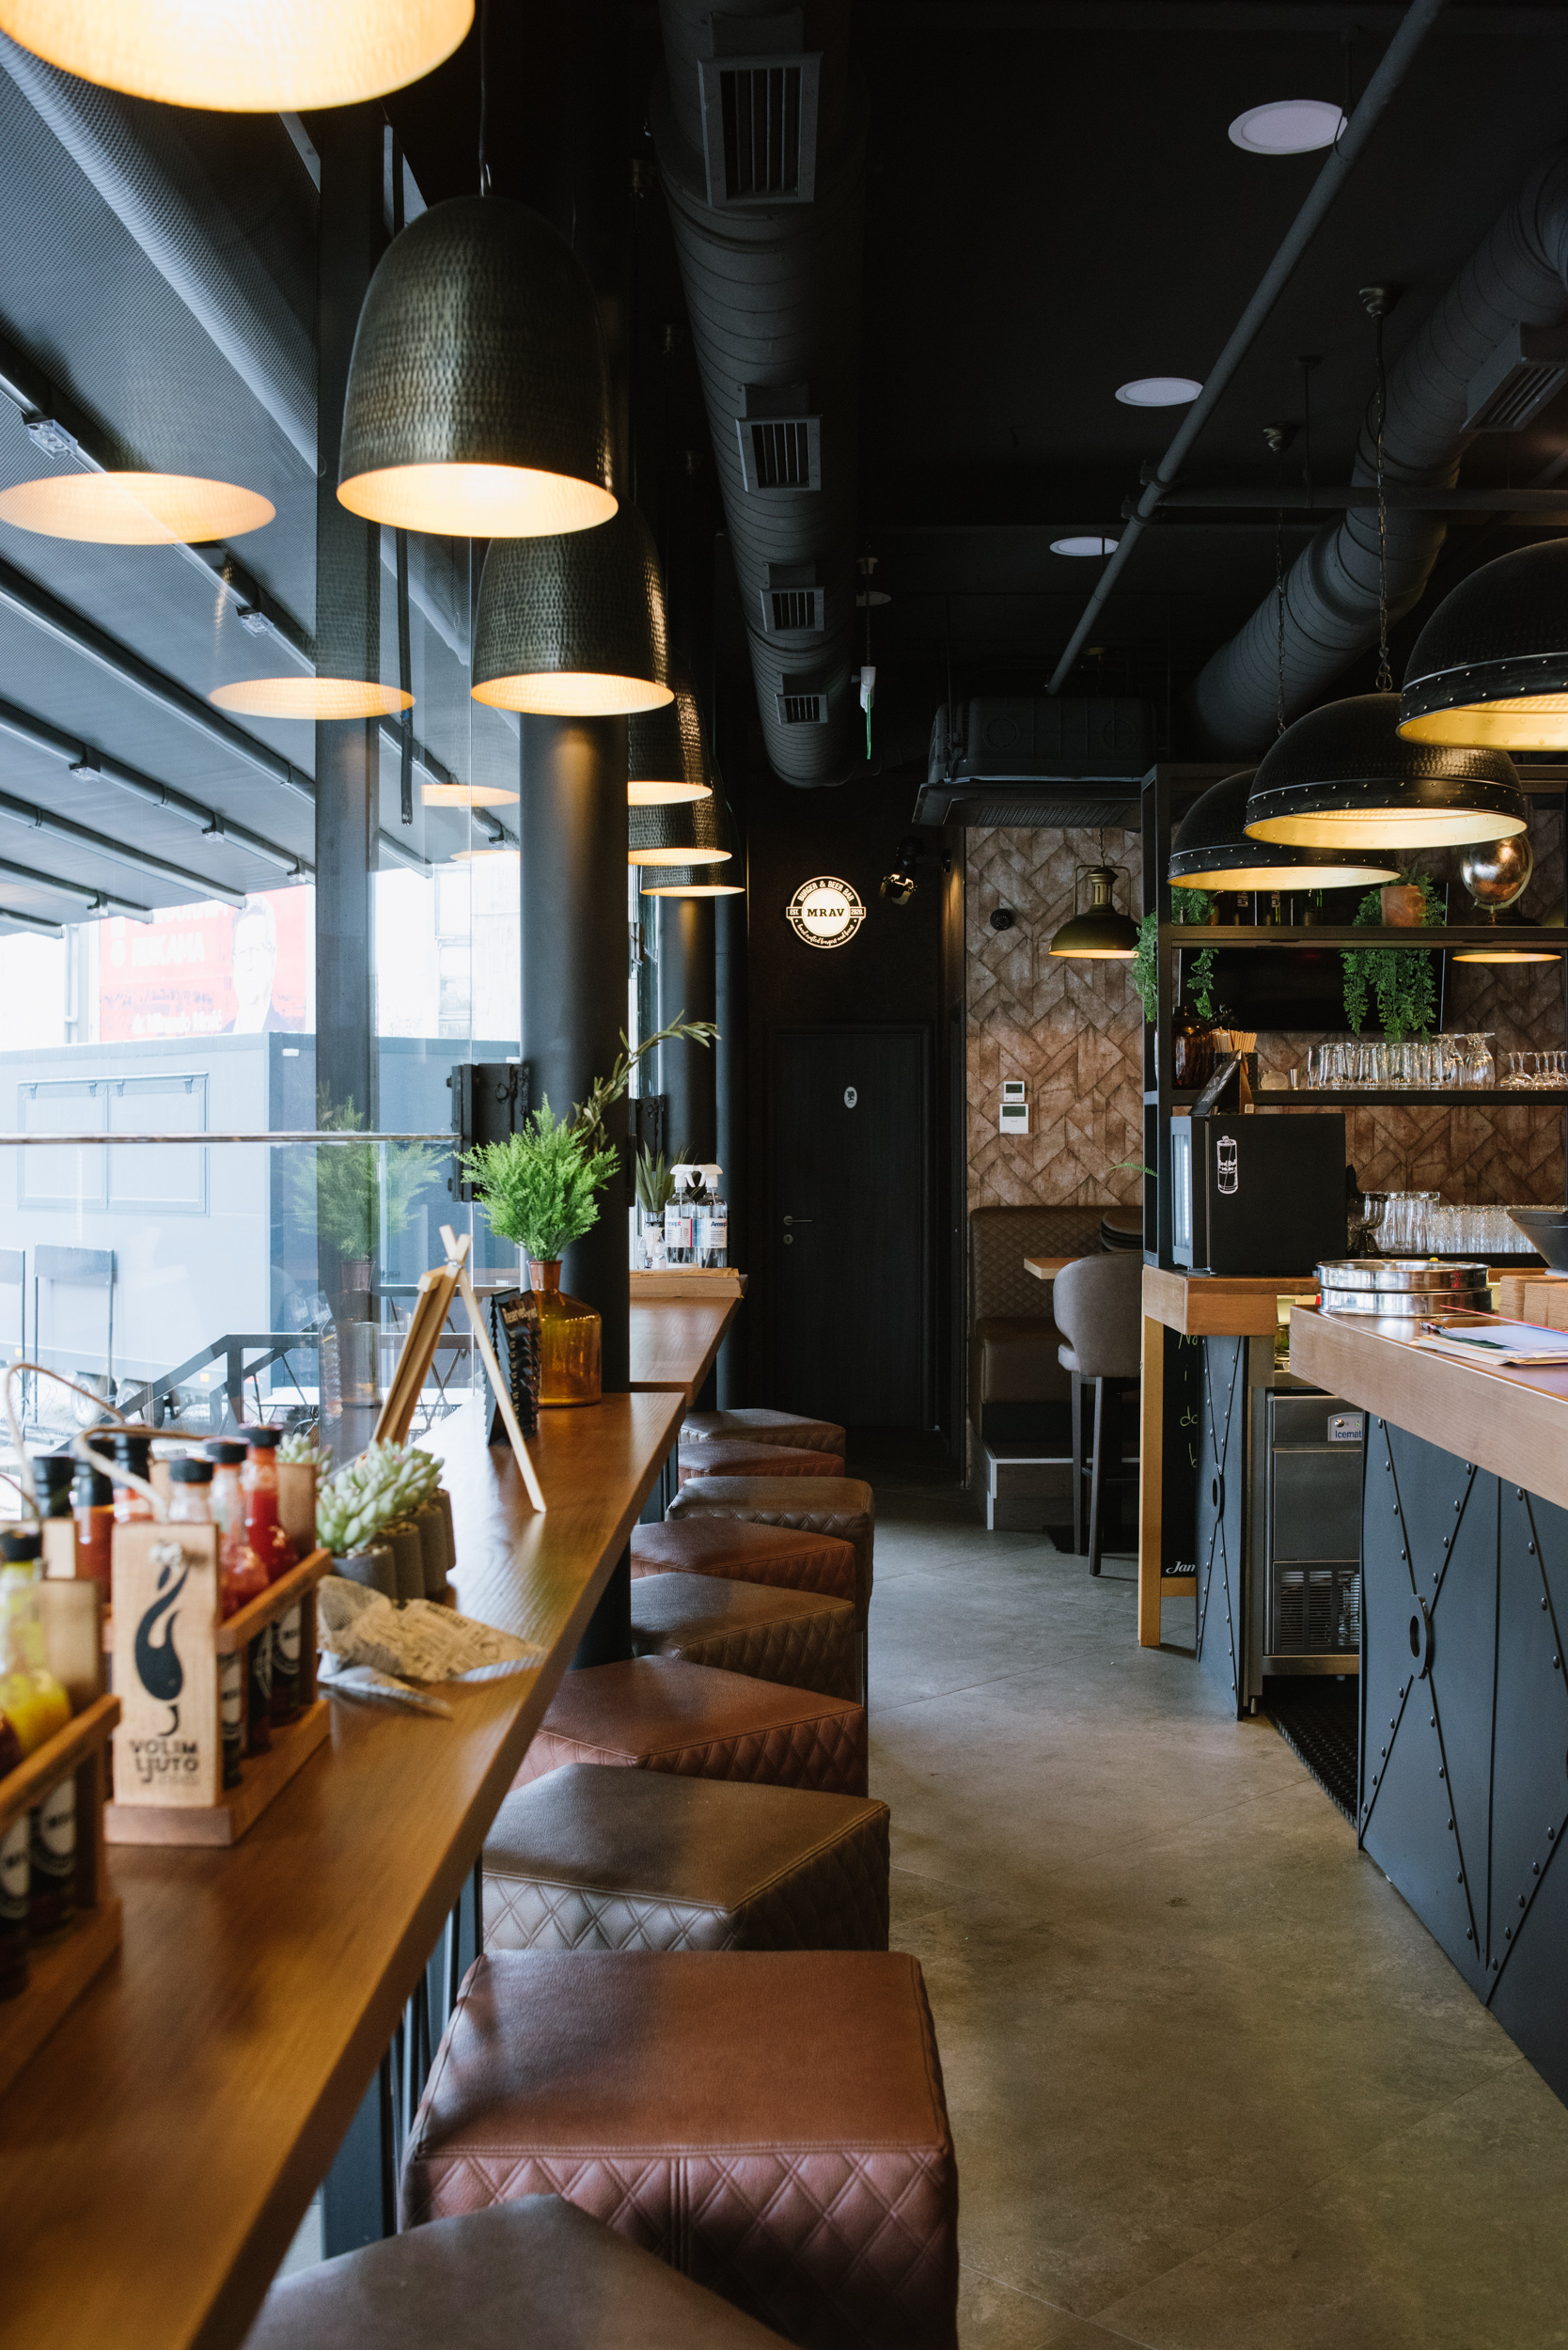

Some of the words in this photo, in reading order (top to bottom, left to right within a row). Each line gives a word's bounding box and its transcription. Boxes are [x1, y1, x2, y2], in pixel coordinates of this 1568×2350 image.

[797, 882, 818, 901] BURGER
[819, 880, 826, 888] &
[827, 880, 844, 892] BEER
[842, 887, 855, 901] BAR
[807, 908, 845, 917] MRAV
